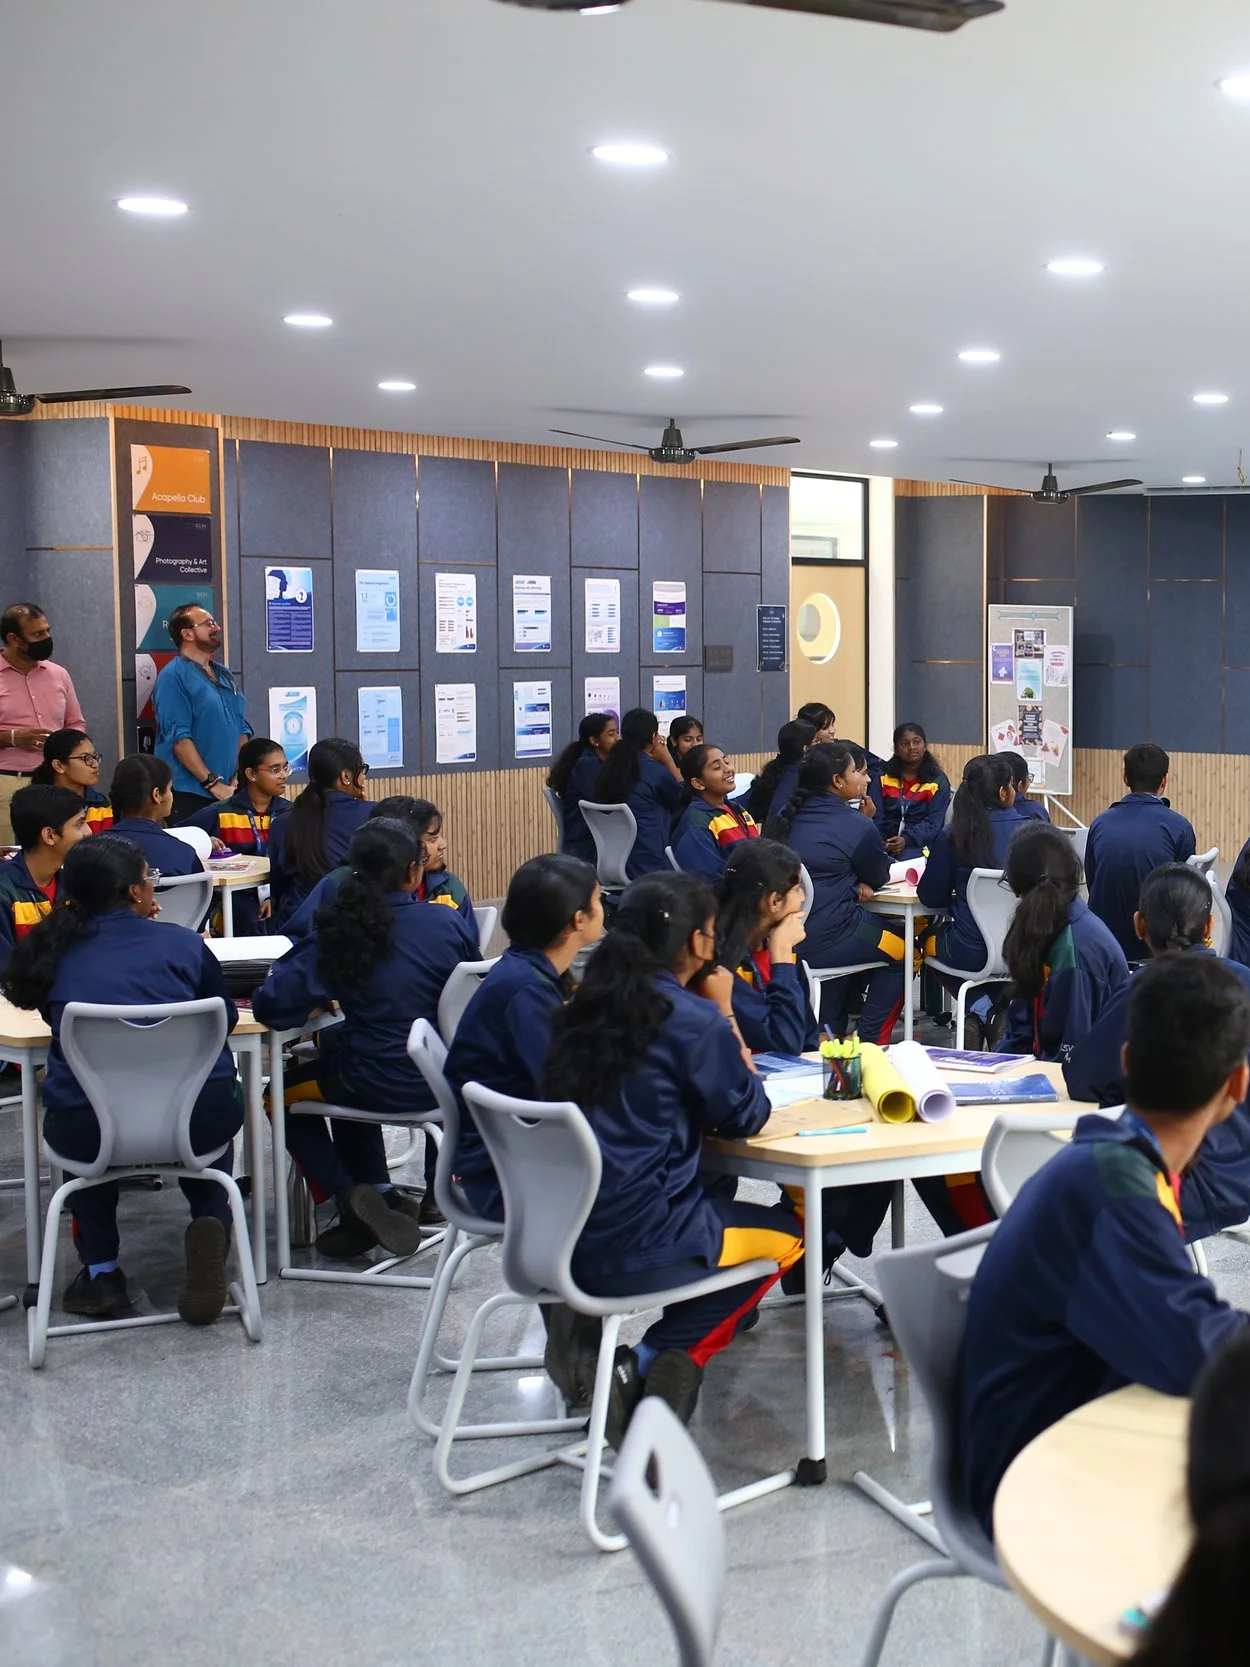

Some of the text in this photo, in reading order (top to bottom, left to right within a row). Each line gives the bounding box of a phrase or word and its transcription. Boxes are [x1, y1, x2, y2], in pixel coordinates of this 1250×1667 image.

[152, 492, 206, 503] Acapella Club
[155, 557, 193, 566] Photography
[179, 566, 207, 574] Collective
